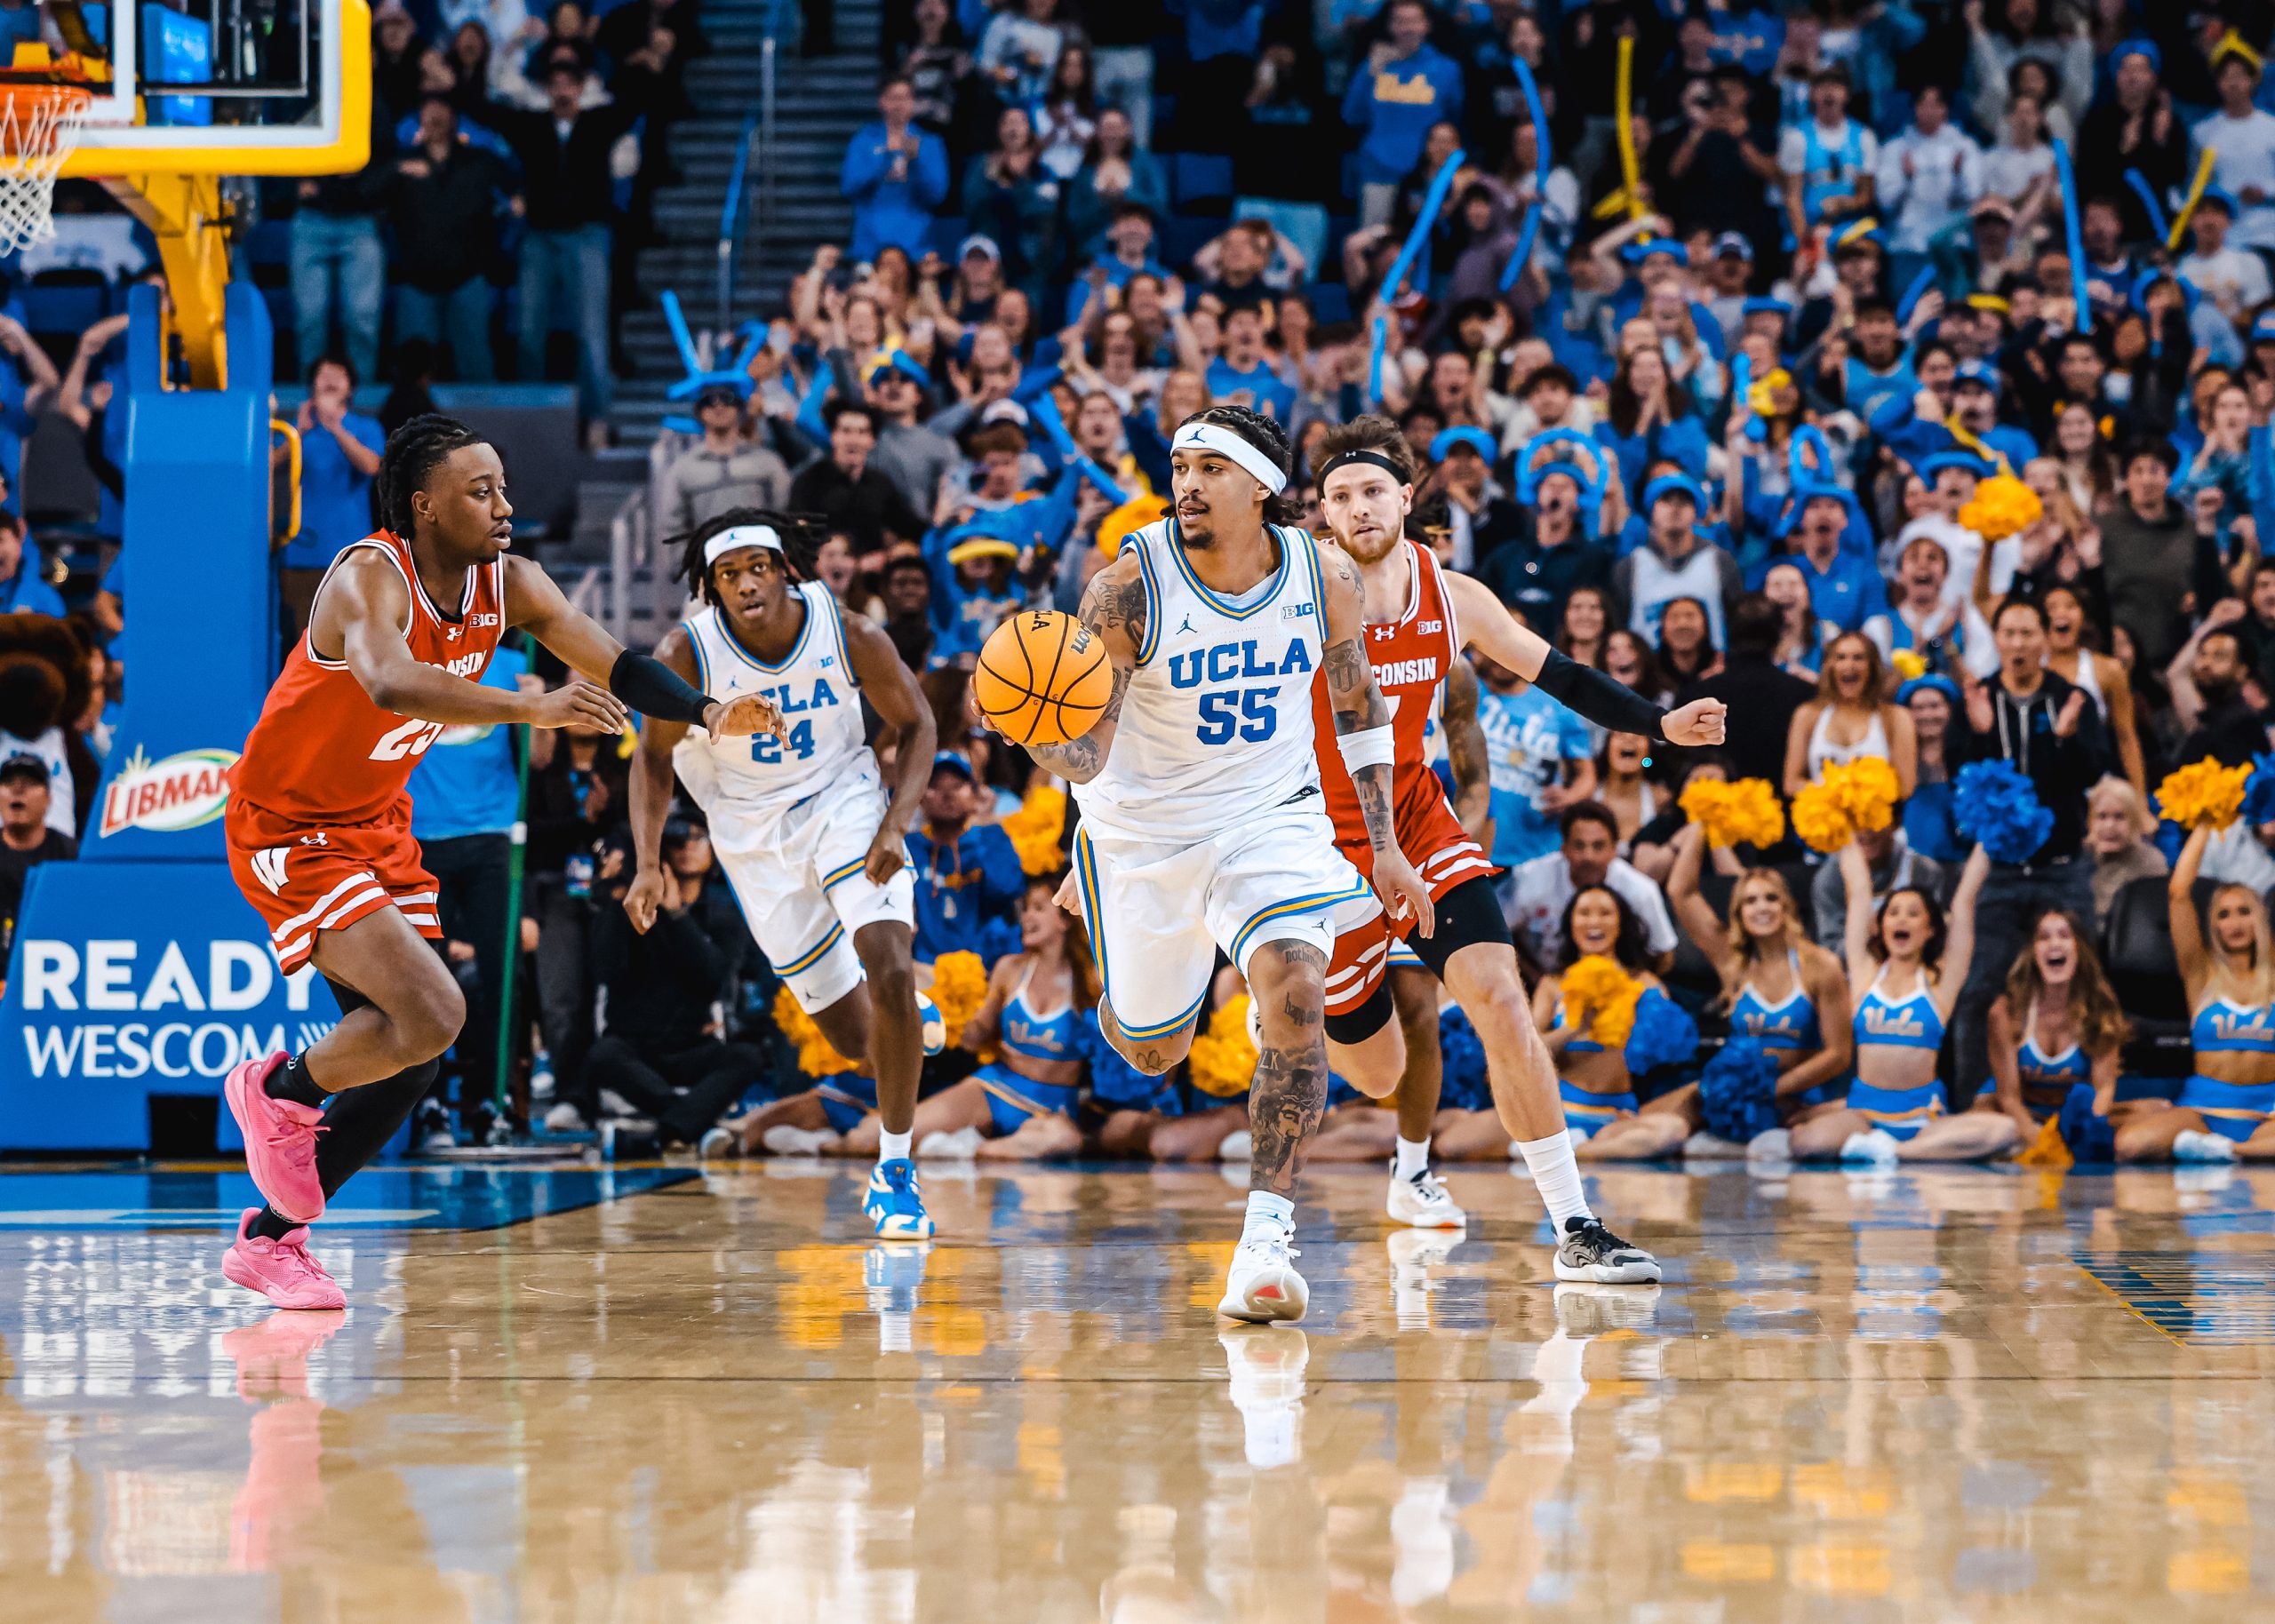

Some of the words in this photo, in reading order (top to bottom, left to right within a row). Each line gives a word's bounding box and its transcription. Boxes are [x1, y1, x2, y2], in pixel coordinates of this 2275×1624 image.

[1169, 639, 1312, 689] UCLA
[751, 720, 815, 763] 24
[1196, 685, 1281, 744] 55
[22, 939, 316, 1011] READY
[23, 1023, 286, 1078] WESCOM
